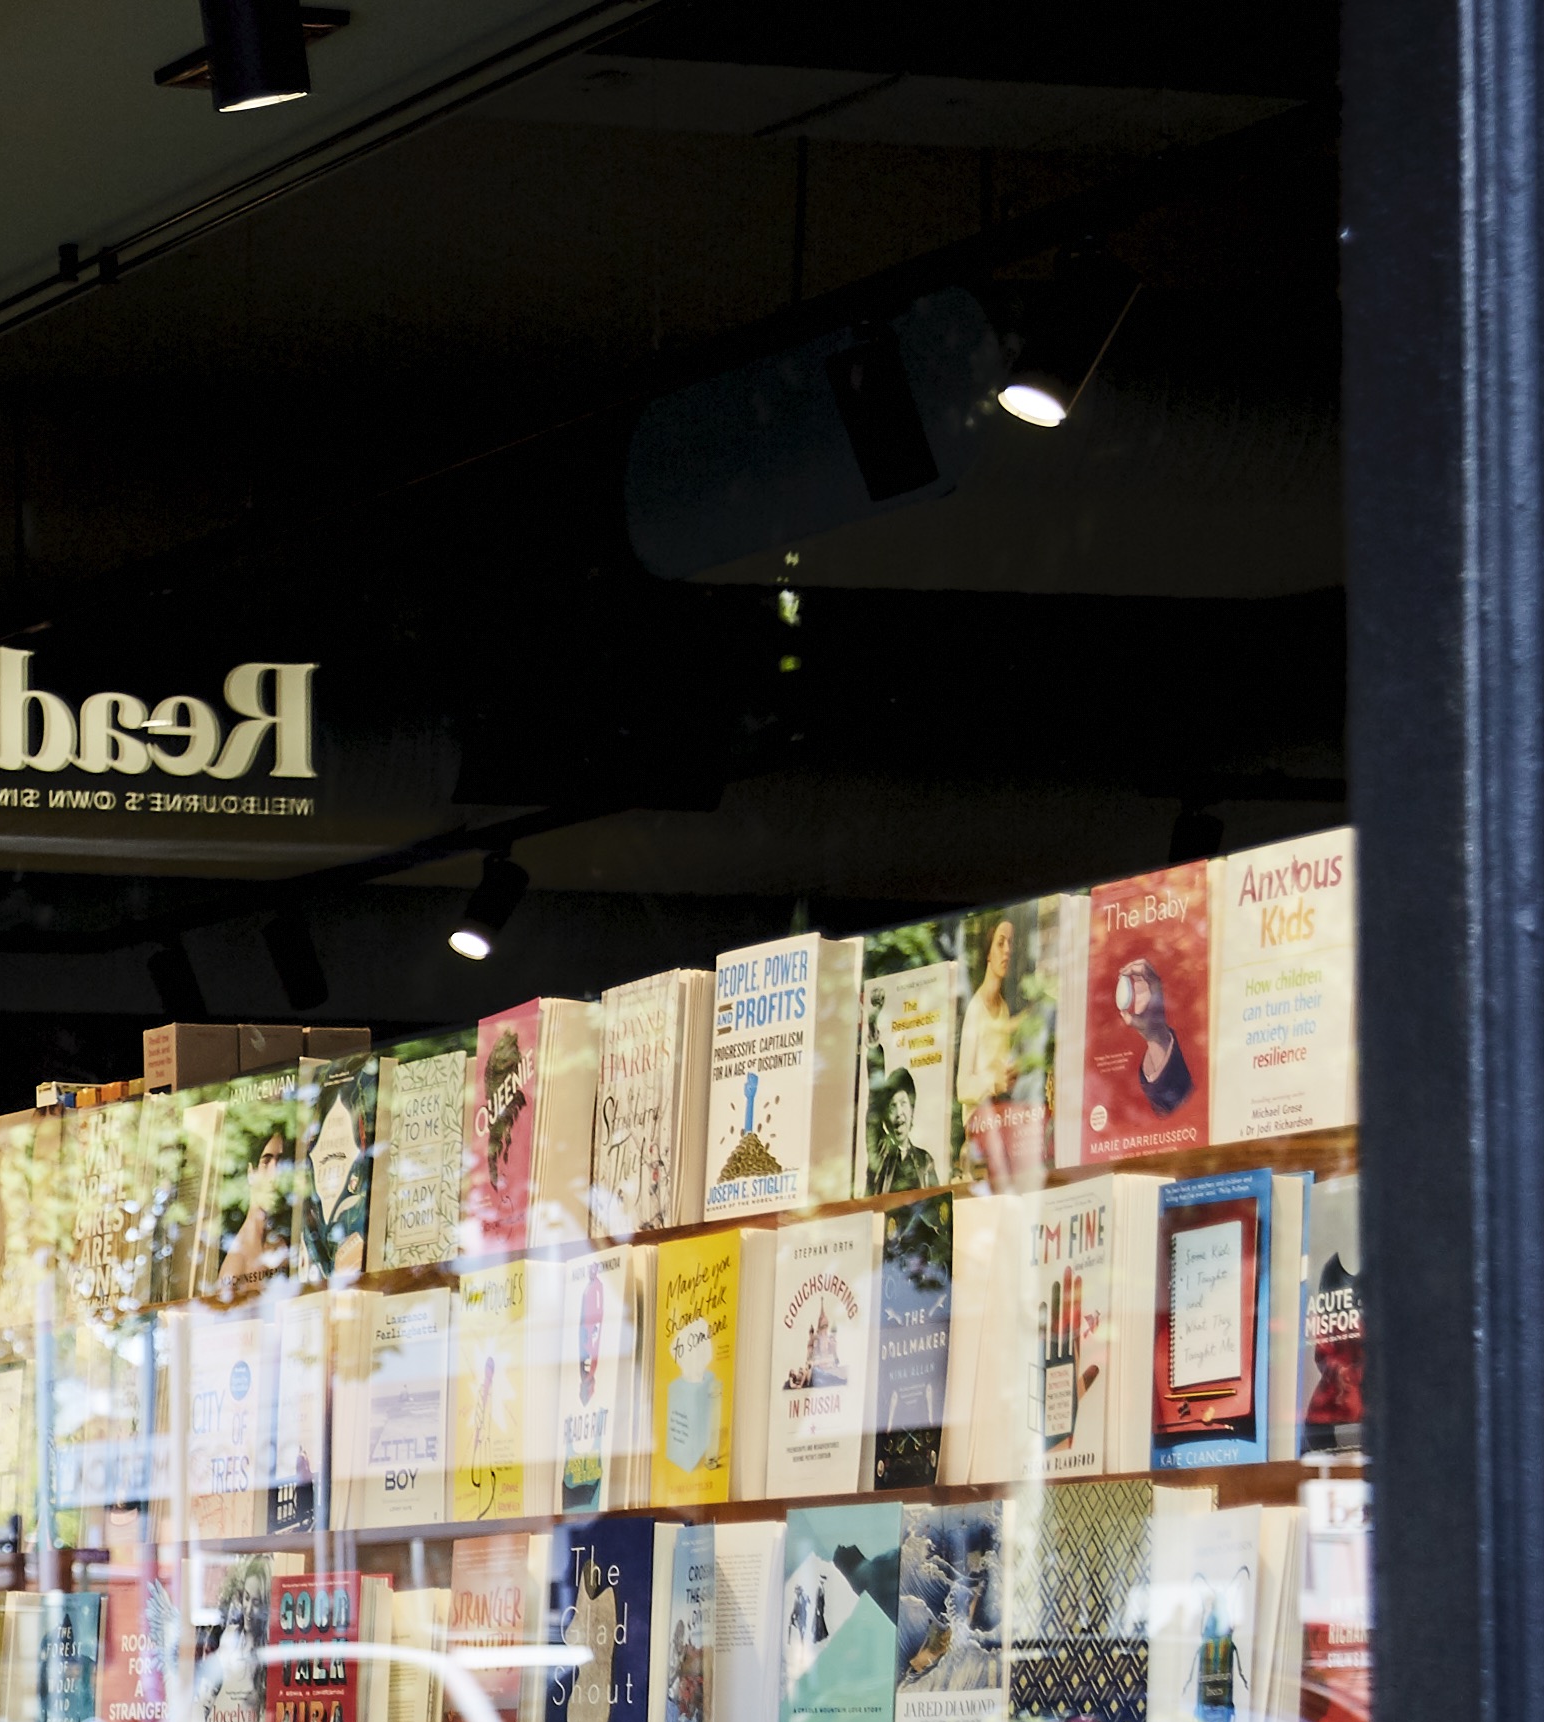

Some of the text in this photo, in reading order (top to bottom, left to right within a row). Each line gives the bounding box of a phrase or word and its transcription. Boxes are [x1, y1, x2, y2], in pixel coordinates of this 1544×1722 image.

[1238, 854, 1343, 906] Anxious
[1103, 890, 1189, 932] The Baby
[1260, 897, 1316, 948] Kids
[763, 950, 808, 988] POWER
[1245, 967, 1322, 997] How children
[716, 987, 806, 1031] AND PROFITS
[1242, 991, 1323, 1022] can turn their
[714, 1030, 804, 1063] PROGRESSIVE CAPITALISM
[1245, 1018, 1316, 1046] anxiety into
[601, 1037, 671, 1085] HARRIS
[713, 1050, 803, 1082] FOR AN AGE OF DISCONTENT
[1252, 1045, 1307, 1069] resilience
[405, 1094, 441, 1118] GREEK
[475, 1050, 535, 1137] QUEENIE
[405, 1117, 440, 1142] TO ME
[1090, 1128, 1197, 1154] MARIE DARRIEUSSECQ
[400, 1184, 436, 1208] MARY
[707, 1174, 797, 1206] JOSEPH E. STIGLITZ
[400, 1210, 435, 1230] NORRIS
[1069, 1205, 1106, 1259] FINE
[81, 1234, 112, 1266] ARE
[794, 1240, 854, 1261] STEPHAN ORTH
[666, 1266, 710, 1310] Maybe
[711, 1255, 732, 1288] you
[664, 1284, 729, 1339] should talk
[784, 1273, 859, 1330] COUCHSURFING
[904, 1308, 925, 1327] THE
[1307, 1288, 1353, 1316] ACUTE
[673, 1314, 729, 1364] to someone
[881, 1331, 946, 1361] DOLLMAKER
[192, 1389, 226, 1434] CITY
[789, 1394, 841, 1419] IN RUSSIA
[231, 1410, 248, 1446] OF
[369, 1436, 438, 1464] LITTLE
[1160, 1447, 1240, 1467] KATE CLANCHY
[211, 1455, 249, 1495] TREES
[385, 1468, 419, 1491] BOY
[571, 1545, 620, 1587] The
[280, 1589, 350, 1634] GOOD
[561, 1602, 627, 1646] Glad
[57, 1626, 72, 1638] THE
[129, 1657, 152, 1675] FOR
[134, 1684, 144, 1697] A
[552, 1664, 634, 1706] Shout
[109, 1702, 168, 1721] STRANGER
[903, 1698, 996, 1719] JARED DIAMOND
